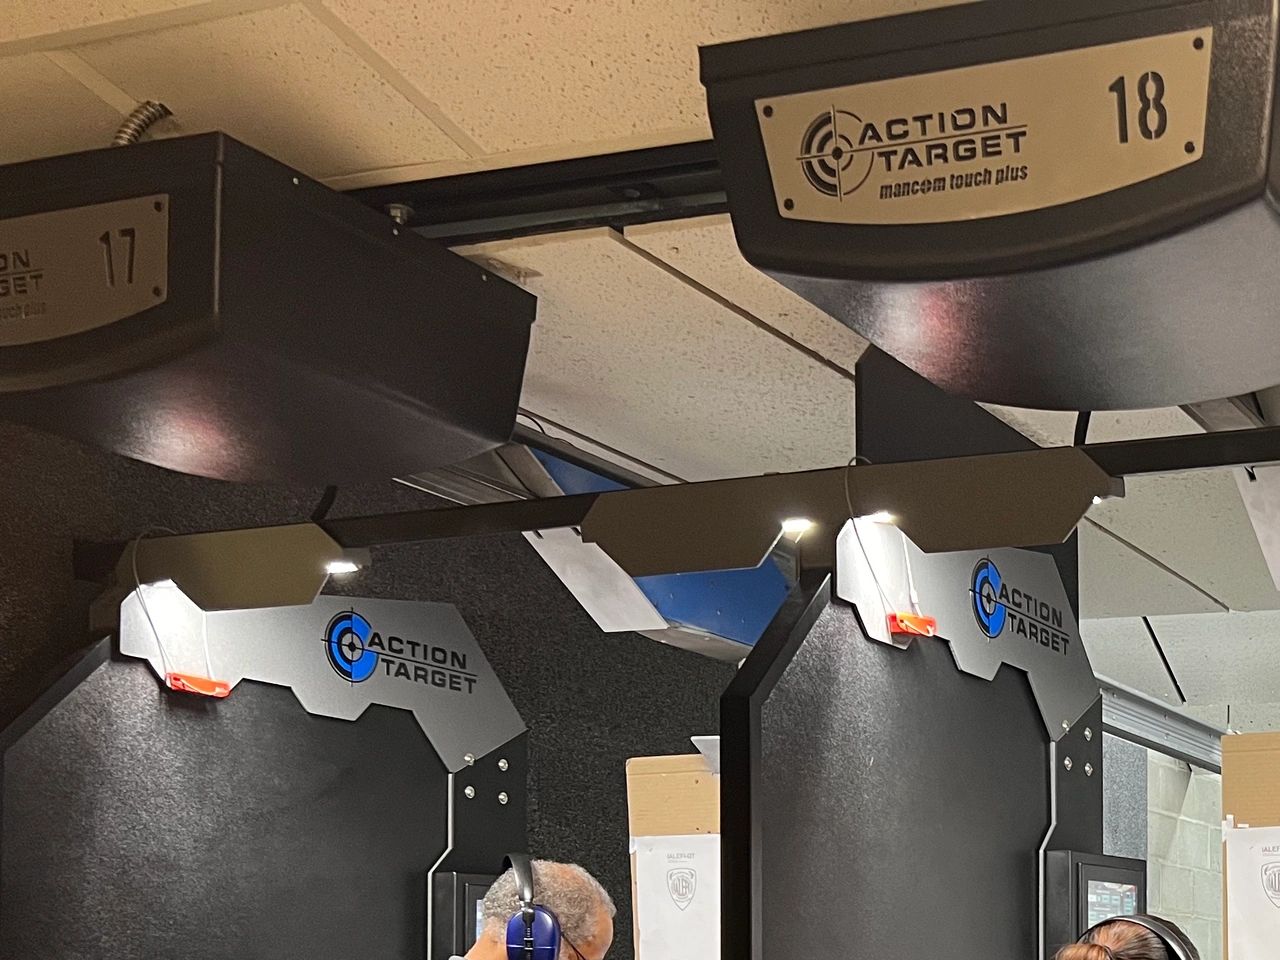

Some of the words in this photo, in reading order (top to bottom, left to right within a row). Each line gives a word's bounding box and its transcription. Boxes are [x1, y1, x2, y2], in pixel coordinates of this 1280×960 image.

[858, 102, 1008, 145] ACTION
[1108, 71, 1168, 144] 18
[877, 130, 1027, 172] TARGET
[879, 176, 946, 200] mancom
[949, 168, 992, 191] touch
[995, 165, 1028, 185] plus
[99, 227, 136, 287] 17
[999, 582, 1063, 628] ACTION
[368, 631, 467, 670] ACTION
[1008, 611, 1070, 656] TARGET
[380, 657, 477, 694] TARGET
